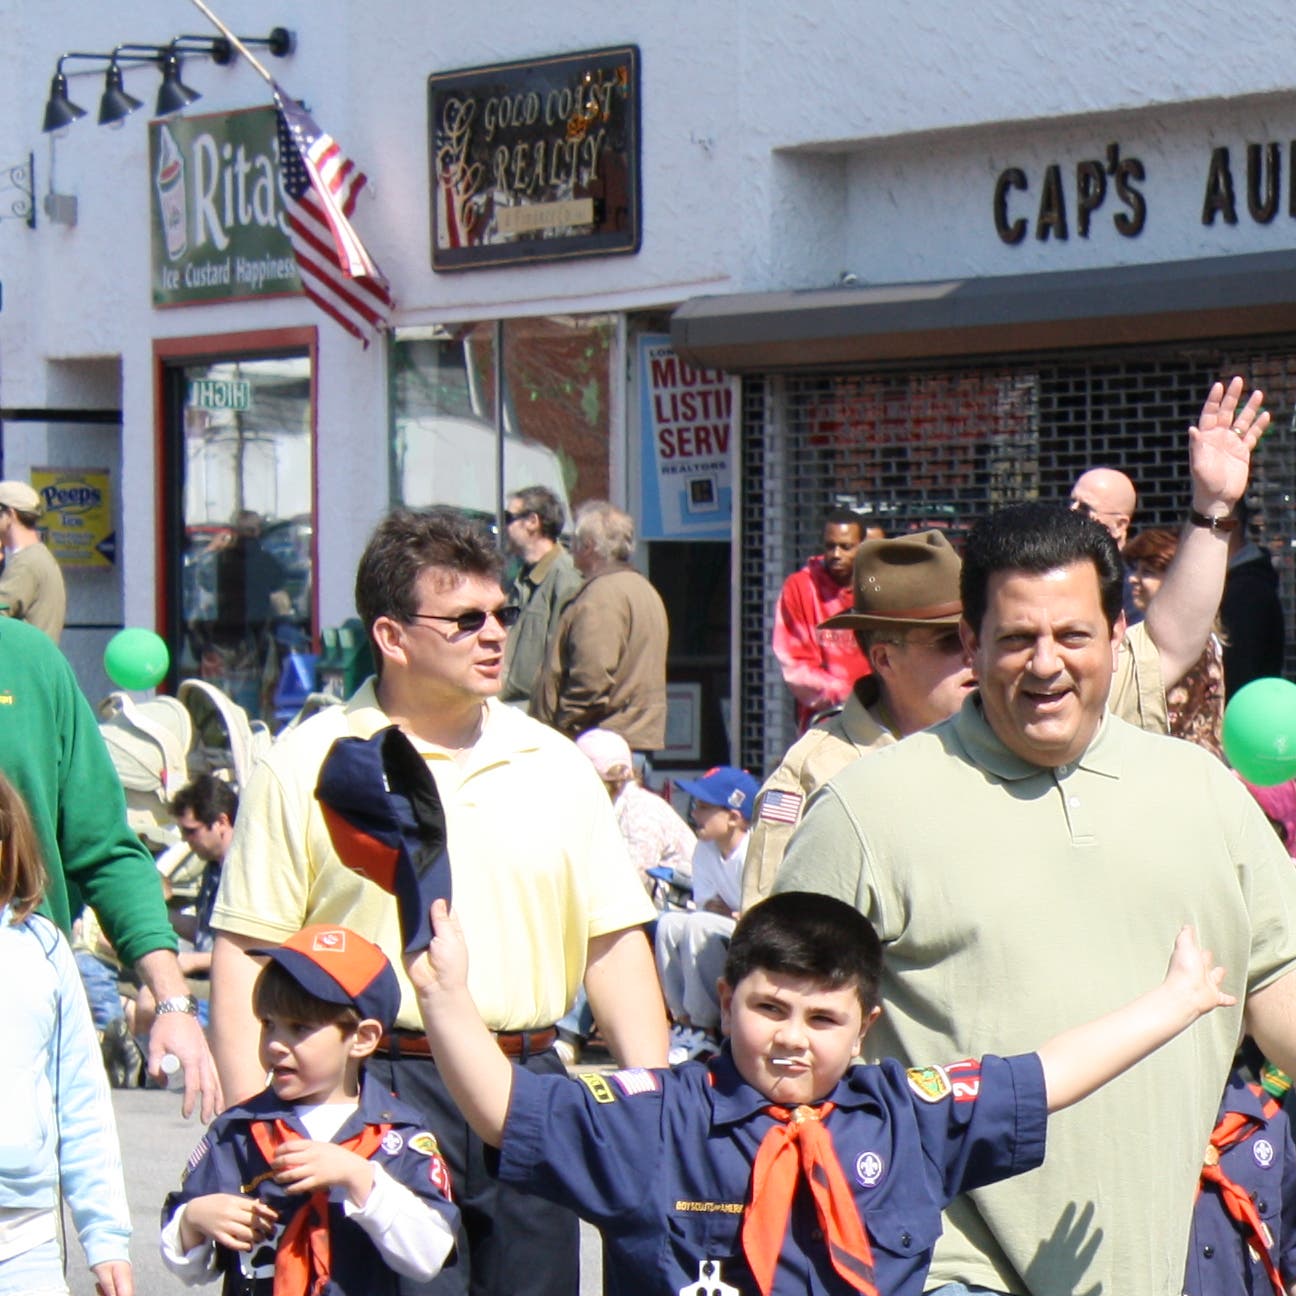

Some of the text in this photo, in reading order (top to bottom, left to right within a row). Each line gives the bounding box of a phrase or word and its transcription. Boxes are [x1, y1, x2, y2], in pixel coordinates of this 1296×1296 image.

[484, 92, 540, 142] GOLD
[493, 128, 606, 198] REALTY
[993, 142, 1147, 245] CAP'S
[163, 253, 297, 289] Ice Custard Happiness
